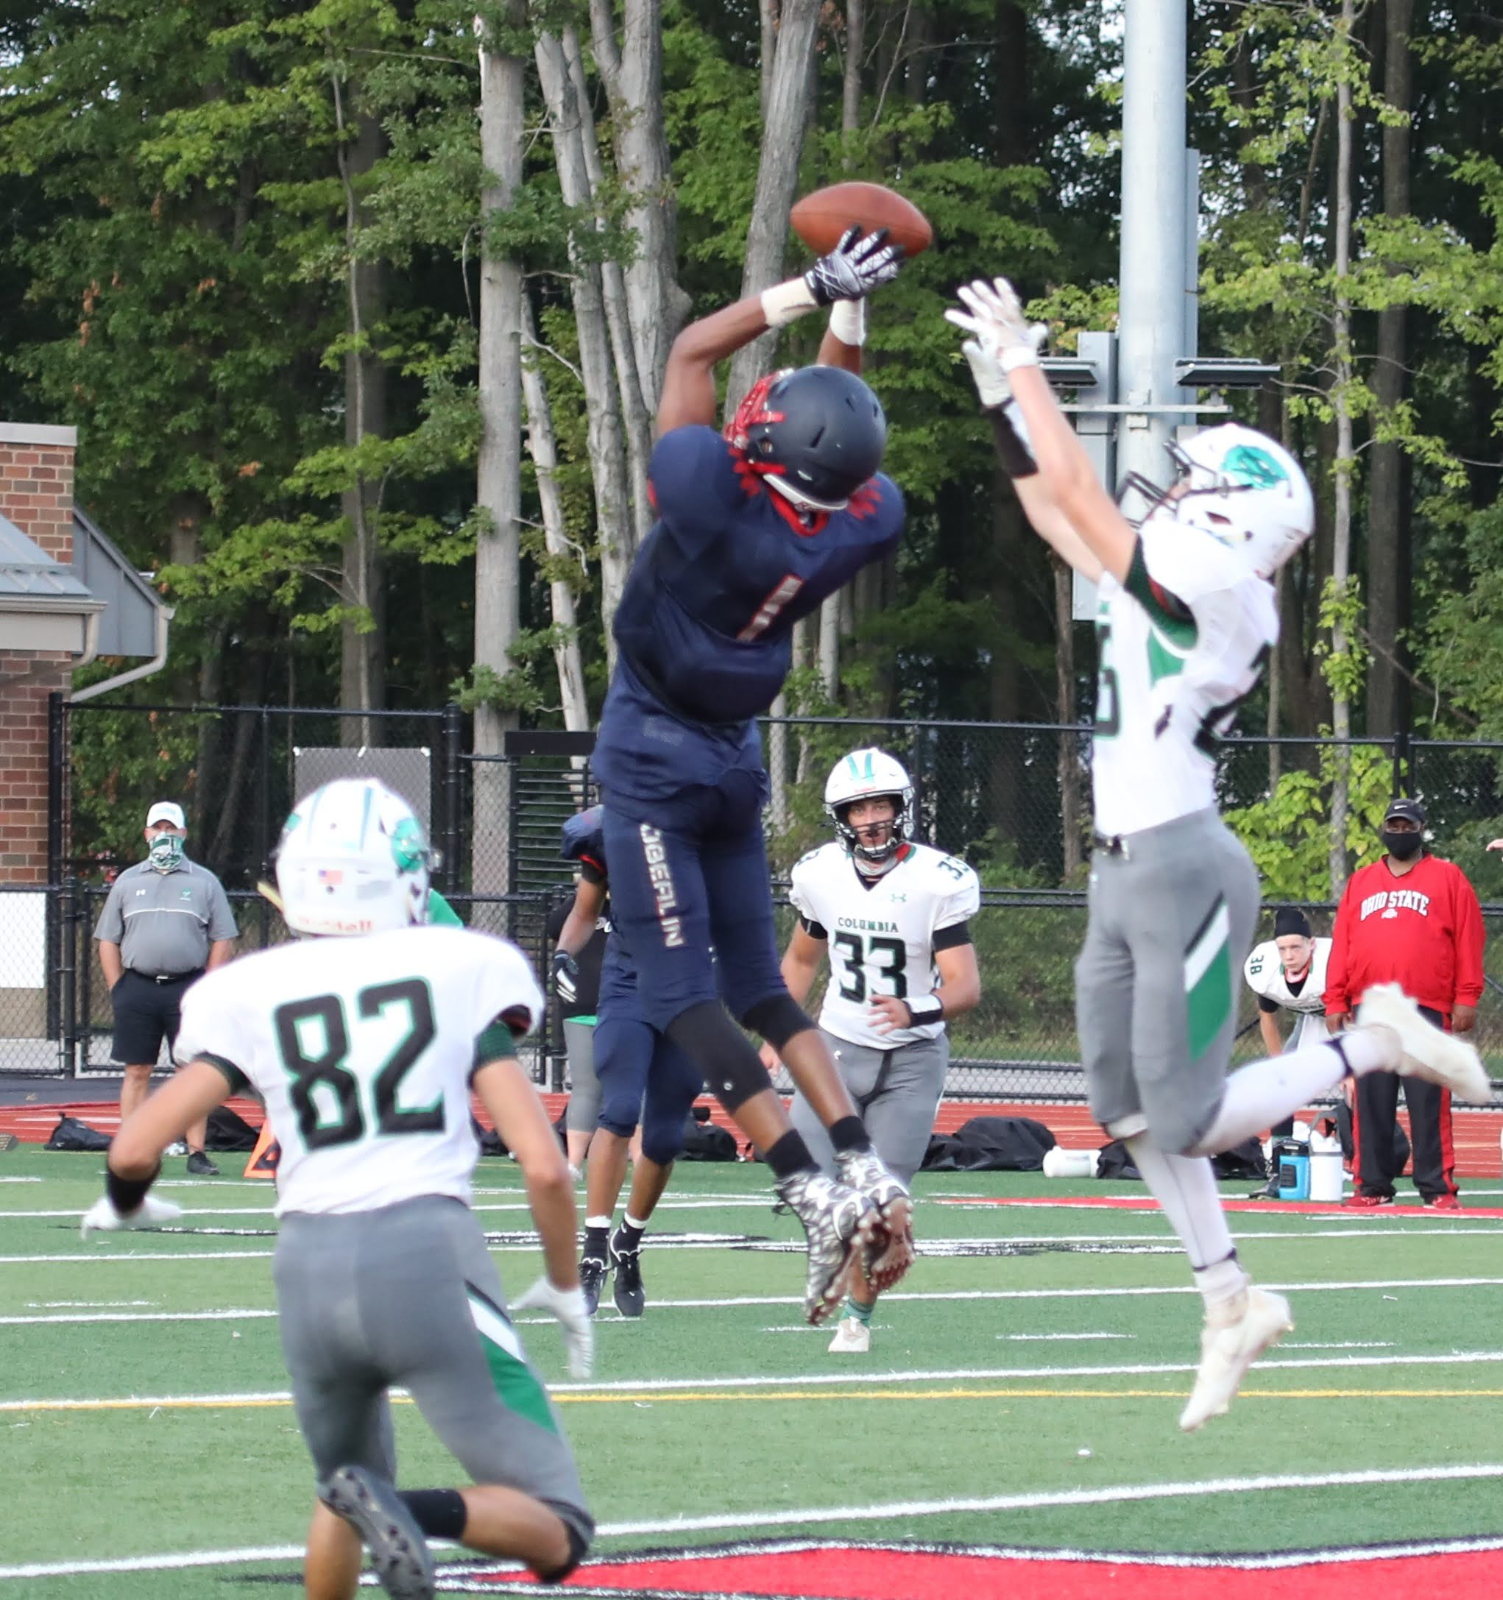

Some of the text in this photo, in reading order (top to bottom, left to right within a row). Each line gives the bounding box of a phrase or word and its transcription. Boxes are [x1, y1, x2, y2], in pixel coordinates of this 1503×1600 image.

[737, 573, 805, 642] 1
[837, 916, 899, 934] COLUMBIA
[1360, 889, 1431, 921] OHIO STATE
[834, 928, 907, 1005] 33
[1250, 954, 1265, 975] 38
[272, 975, 447, 1153] 82
